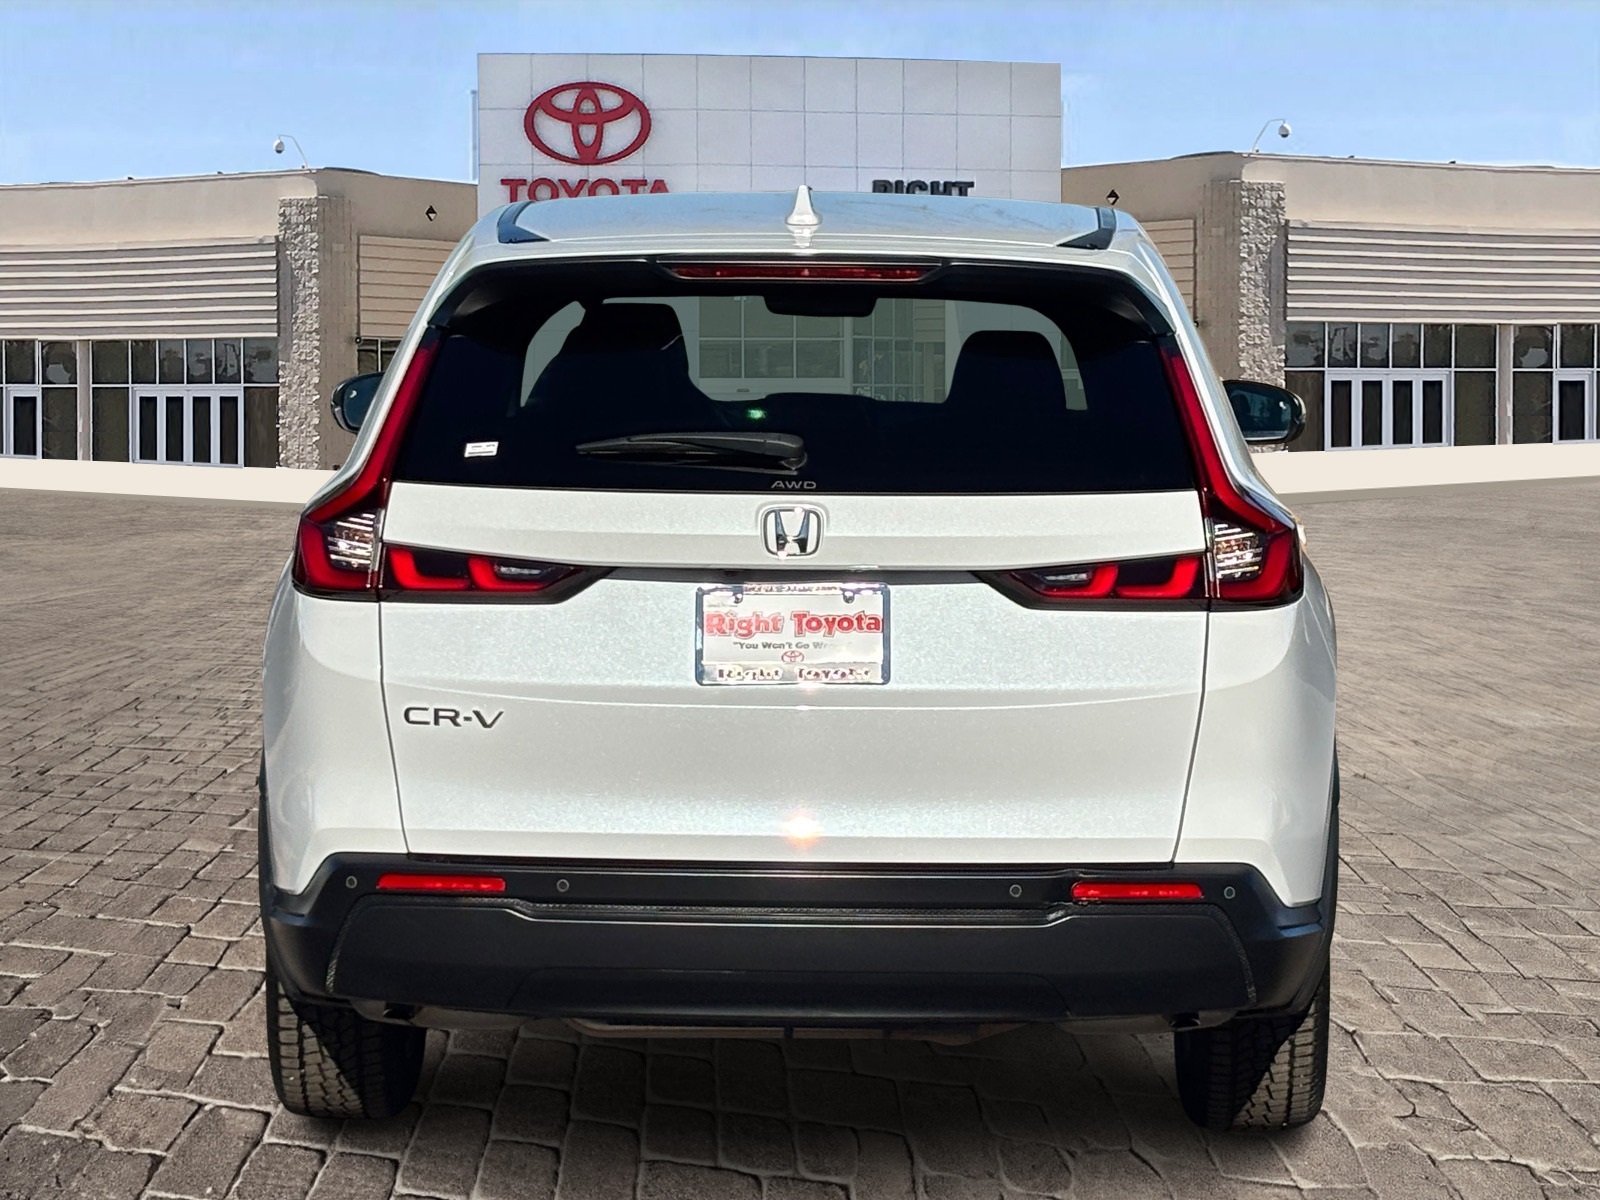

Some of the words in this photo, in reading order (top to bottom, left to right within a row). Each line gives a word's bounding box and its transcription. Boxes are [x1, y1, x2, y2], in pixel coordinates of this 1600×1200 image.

[500, 178, 669, 203] TOYOTA
[771, 480, 817, 489] AWD
[705, 611, 784, 639] Right
[790, 610, 883, 637] Toyota
[761, 641, 793, 650] Won't
[795, 642, 810, 650] Go
[403, 706, 504, 729] CR-V
